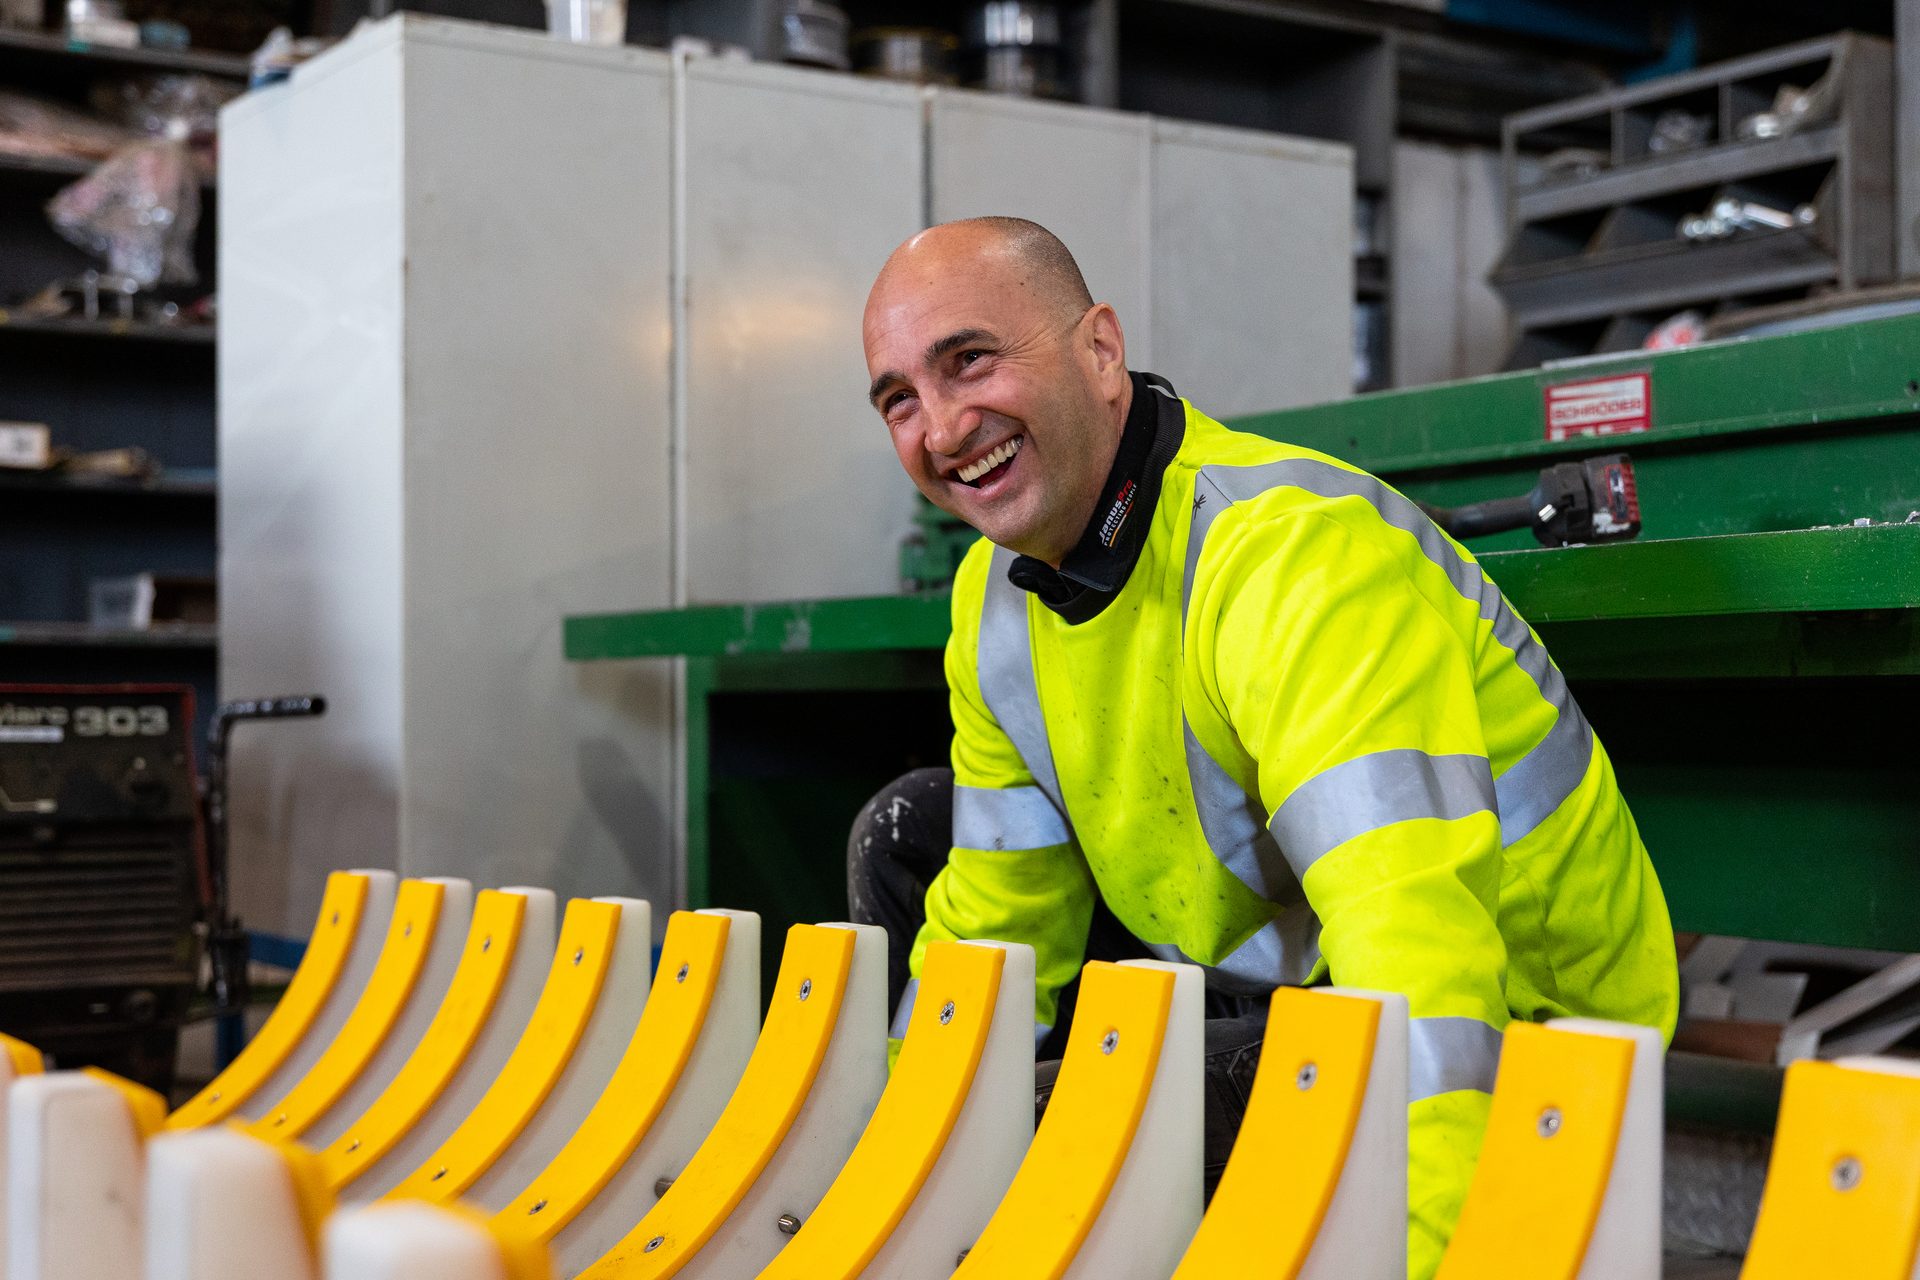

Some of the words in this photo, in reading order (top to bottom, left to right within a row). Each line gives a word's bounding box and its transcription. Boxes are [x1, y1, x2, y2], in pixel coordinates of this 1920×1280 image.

[1104, 506, 1127, 546] PROTECTING
[1125, 484, 1137, 505] PEOPLE
[73, 706, 169, 737] 303
